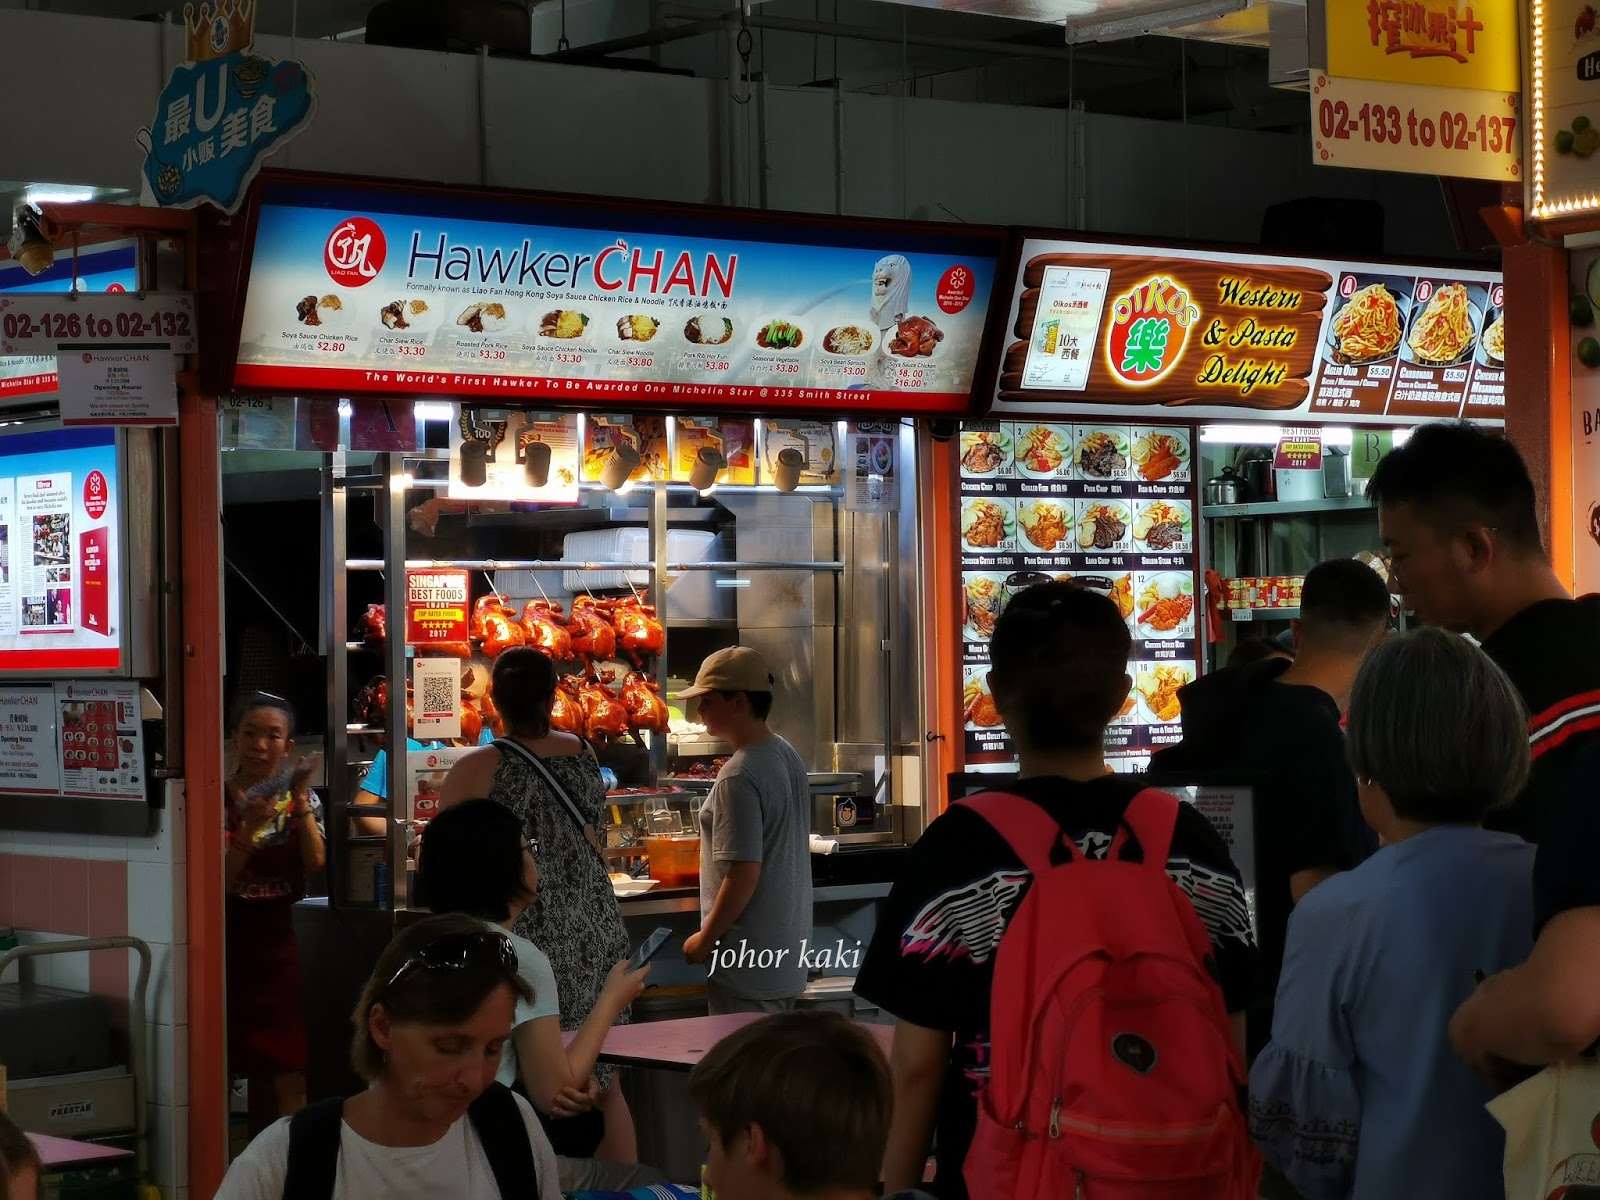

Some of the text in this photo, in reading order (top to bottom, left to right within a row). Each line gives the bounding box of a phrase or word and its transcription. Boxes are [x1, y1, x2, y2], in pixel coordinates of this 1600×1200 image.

[1319, 99, 1516, 154] 02-133 to 02-137
[1345, 279, 1353, 292] A
[406, 282, 437, 293] Formally
[438, 285, 460, 293] known
[472, 286, 488, 295] Liao
[504, 289, 524, 298] Hong
[525, 290, 544, 299] Kong
[546, 292, 564, 300] Soya
[588, 293, 616, 302] Chicken
[617, 296, 632, 304] Rice
[641, 297, 665, 306] Noodle
[1219, 277, 1301, 308] Western
[1421, 285, 1429, 299] B
[3, 312, 191, 339] 02-126 to 02-132
[281, 331, 297, 339] Soya
[319, 333, 344, 341] Chicken
[1203, 318, 1296, 347] & Pasta
[379, 336, 393, 344] Char
[410, 337, 424, 345] Rice
[456, 340, 480, 348] Roasted
[317, 341, 345, 352] $2.80
[398, 345, 426, 356] $3.30
[537, 344, 554, 352] Sauce
[555, 345, 577, 353] Chicken
[479, 349, 505, 360] $3.30
[557, 353, 582, 364] $3.30
[751, 355, 800, 364] Seasonal Vegetable
[628, 357, 653, 367] $3.80
[705, 361, 730, 371] $3.80
[820, 358, 833, 366] Soya
[775, 363, 799, 373] $3.80
[843, 366, 866, 376] $3.00
[1370, 367, 1390, 376] $5.50
[1198, 355, 1287, 393] Delight
[1445, 371, 1465, 380] $5.50
[94, 384, 120, 392] Opening
[366, 371, 871, 401] The World's First Hawker To Be Awarded One Michelin Star @ 335 Smith Street
[895, 378, 922, 388] $16.00
[229, 397, 264, 408] 02-126
[474, 428, 491, 439] 100
[1364, 433, 1381, 463] B
[1173, 471, 1187, 479] $6.50
[1135, 502, 1139, 510] 8
[1000, 541, 1014, 549] $6.50
[1058, 541, 1072, 549] $6.50
[1175, 542, 1188, 550] $8.50
[1138, 575, 1145, 583] 12
[411, 589, 463, 600] BEST FOODS
[429, 630, 447, 638] 2017
[964, 667, 972, 676] 13
[51, 1104, 91, 1117] PRESTAR
